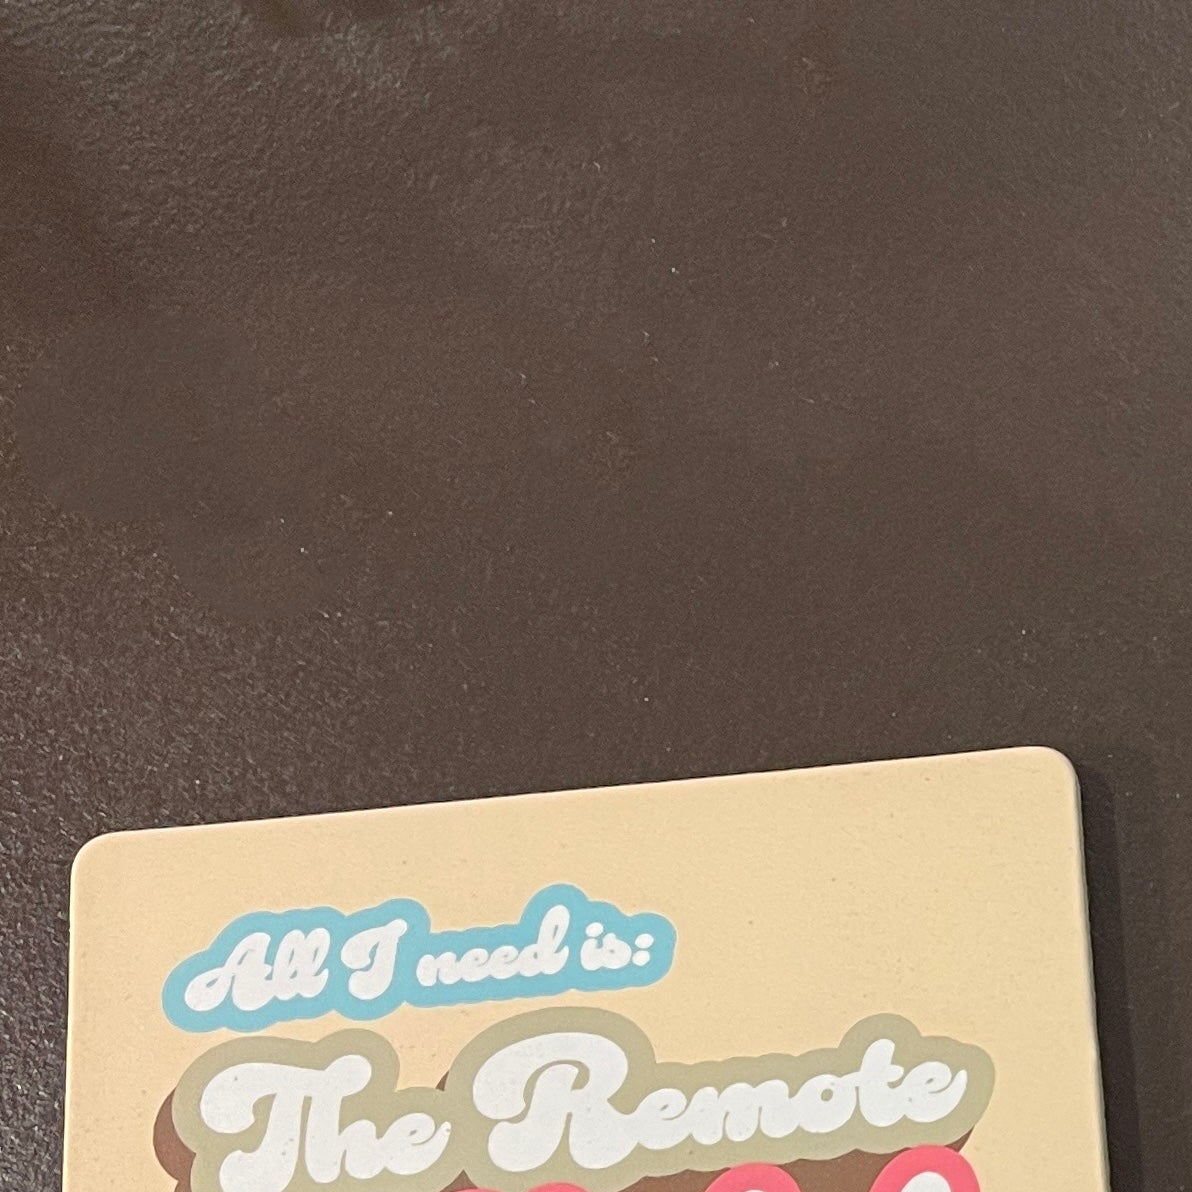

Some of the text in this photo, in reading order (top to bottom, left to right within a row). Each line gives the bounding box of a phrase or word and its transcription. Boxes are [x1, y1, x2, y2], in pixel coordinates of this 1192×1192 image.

[184, 904, 655, 1012] All I need is:
[472, 1032, 969, 1174] Remote
